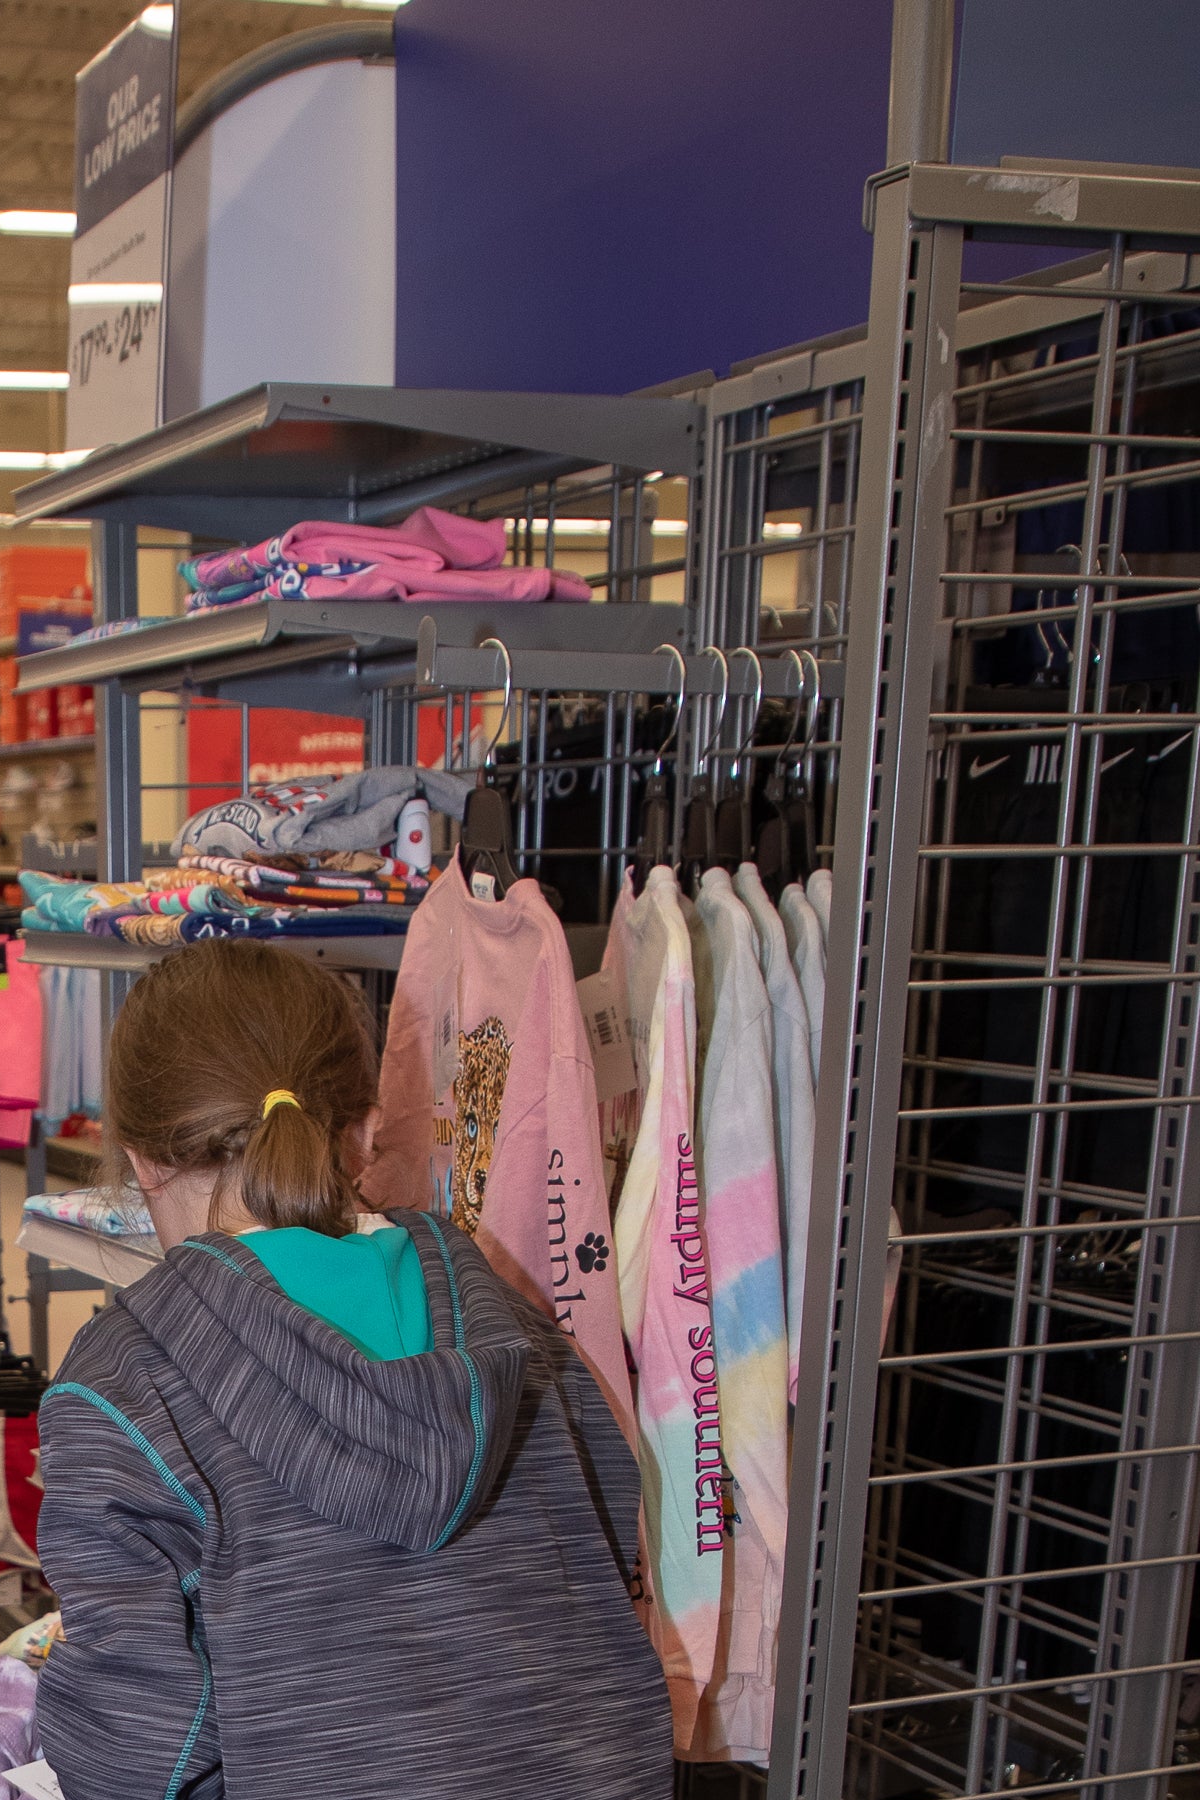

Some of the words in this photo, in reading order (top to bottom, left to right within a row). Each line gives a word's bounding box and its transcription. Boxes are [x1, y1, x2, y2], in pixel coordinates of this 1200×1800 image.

[107, 74, 139, 130] OUR
[84, 129, 117, 188] LOW
[117, 92, 161, 163] PRICE
[1023, 744, 1064, 784] NIK
